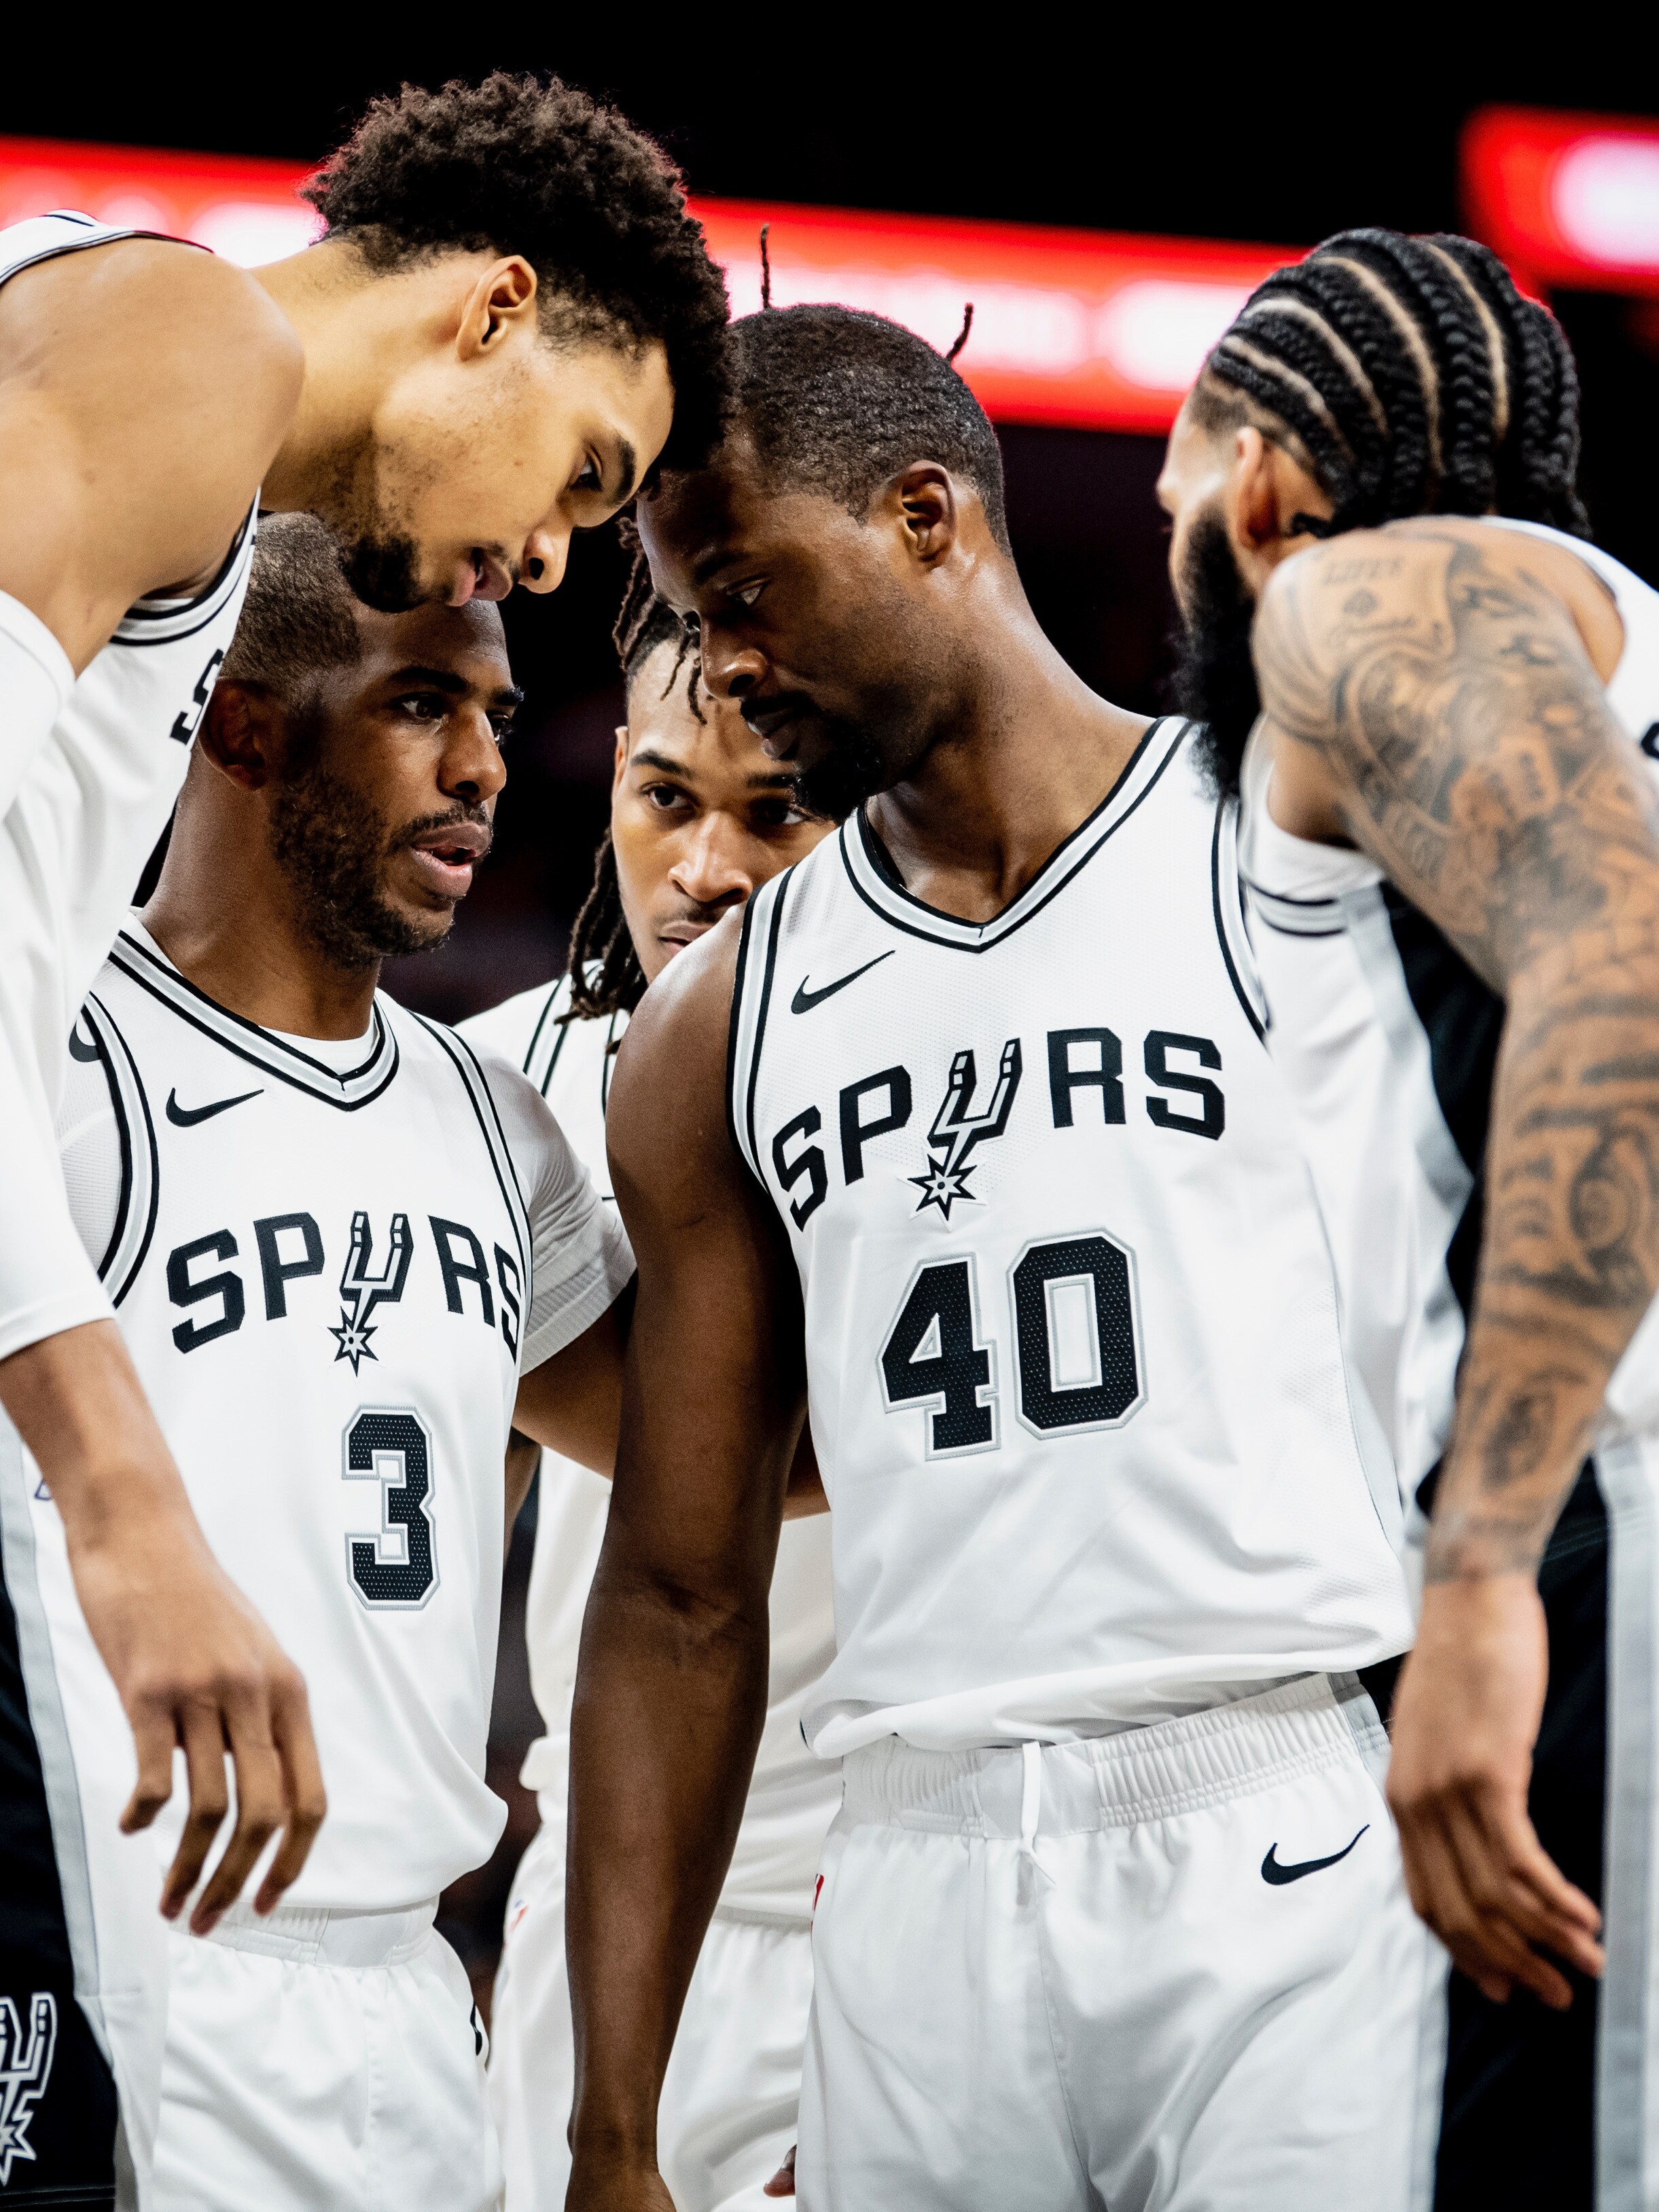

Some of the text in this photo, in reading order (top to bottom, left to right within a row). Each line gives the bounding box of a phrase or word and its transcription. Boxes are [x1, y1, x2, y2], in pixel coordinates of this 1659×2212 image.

[772, 1027, 1225, 1233] SPURS
[166, 1211, 521, 1378] SPURS
[876, 1227, 1149, 1461] 40
[342, 1404, 440, 1611] 3
